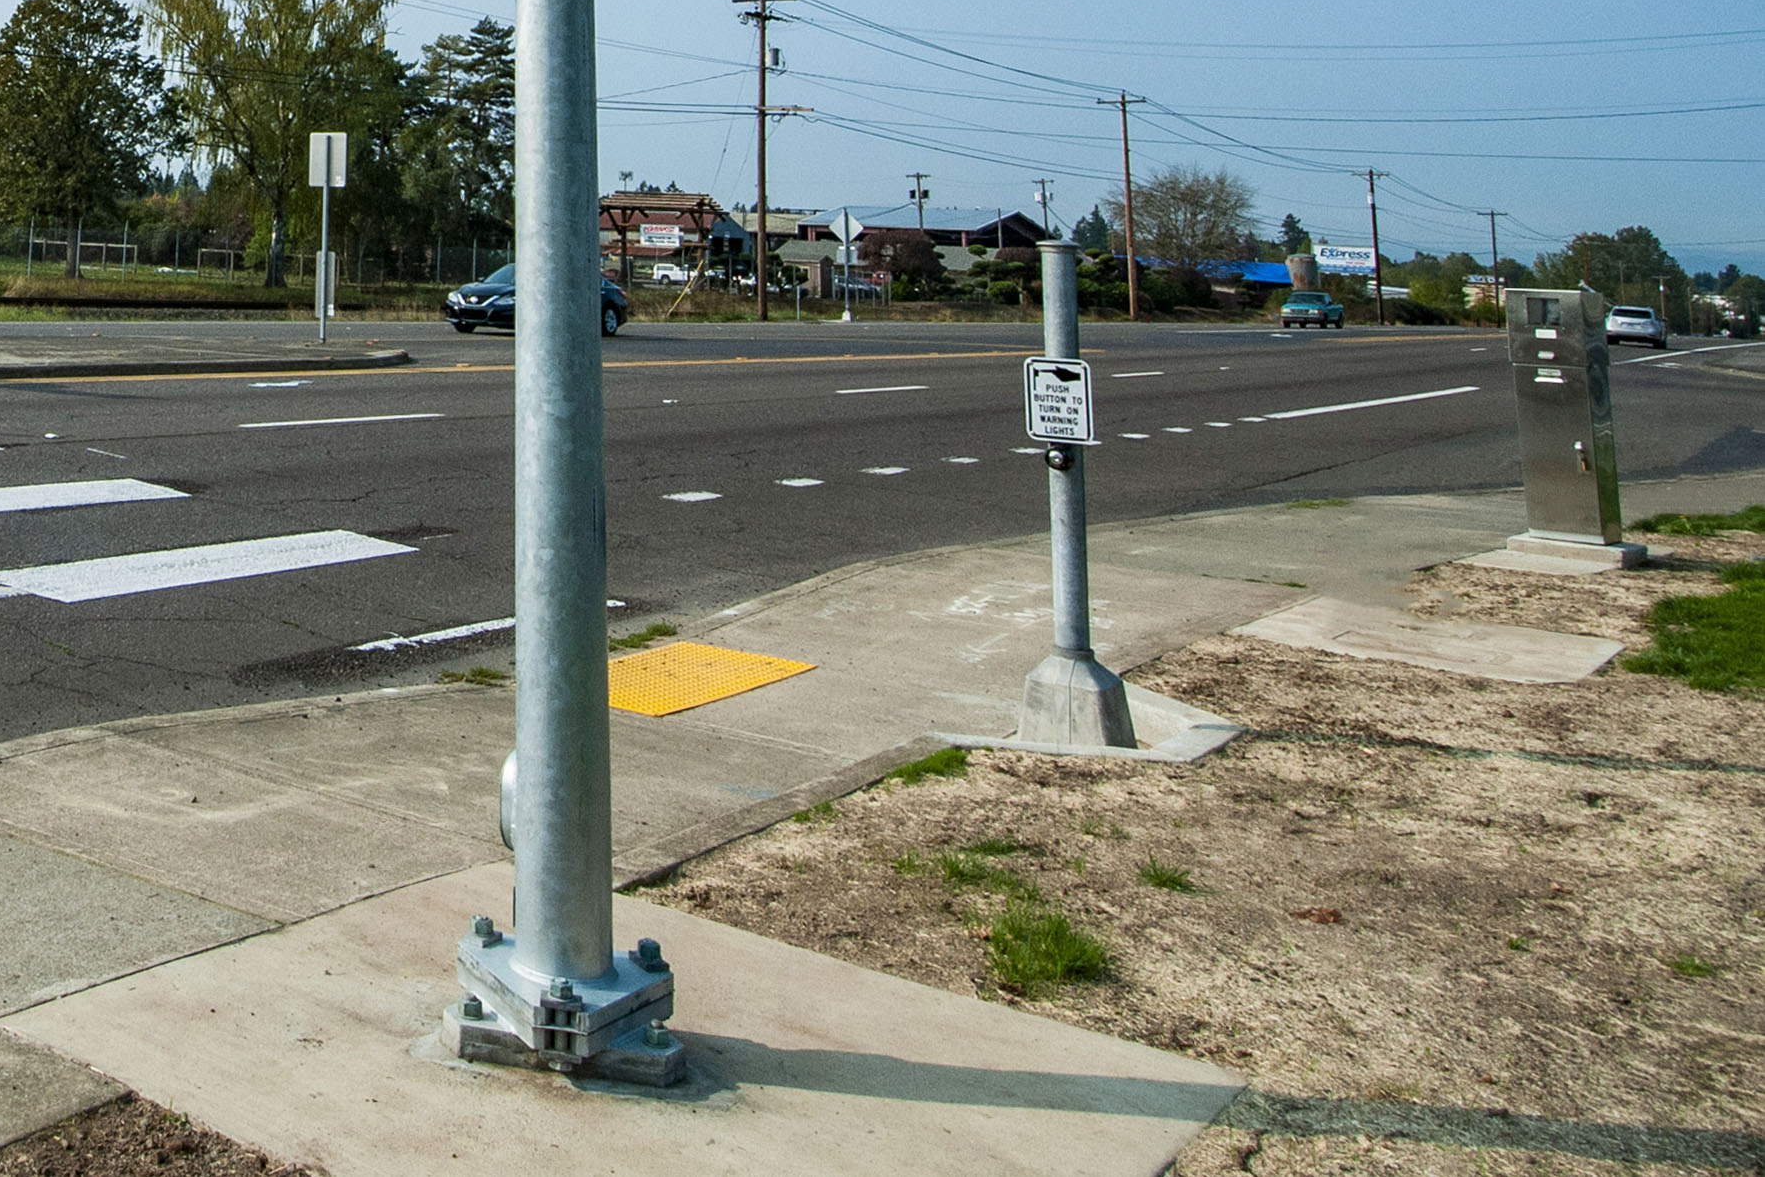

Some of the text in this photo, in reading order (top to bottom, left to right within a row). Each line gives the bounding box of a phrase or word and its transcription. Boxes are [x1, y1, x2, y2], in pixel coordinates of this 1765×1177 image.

[1045, 384, 1070, 393] PUSH
[1034, 394, 1083, 405] BUTTON TO
[1039, 404, 1079, 415] TURN ON
[1040, 415, 1079, 426] WARNING
[1044, 425, 1075, 436] LIGHTS
